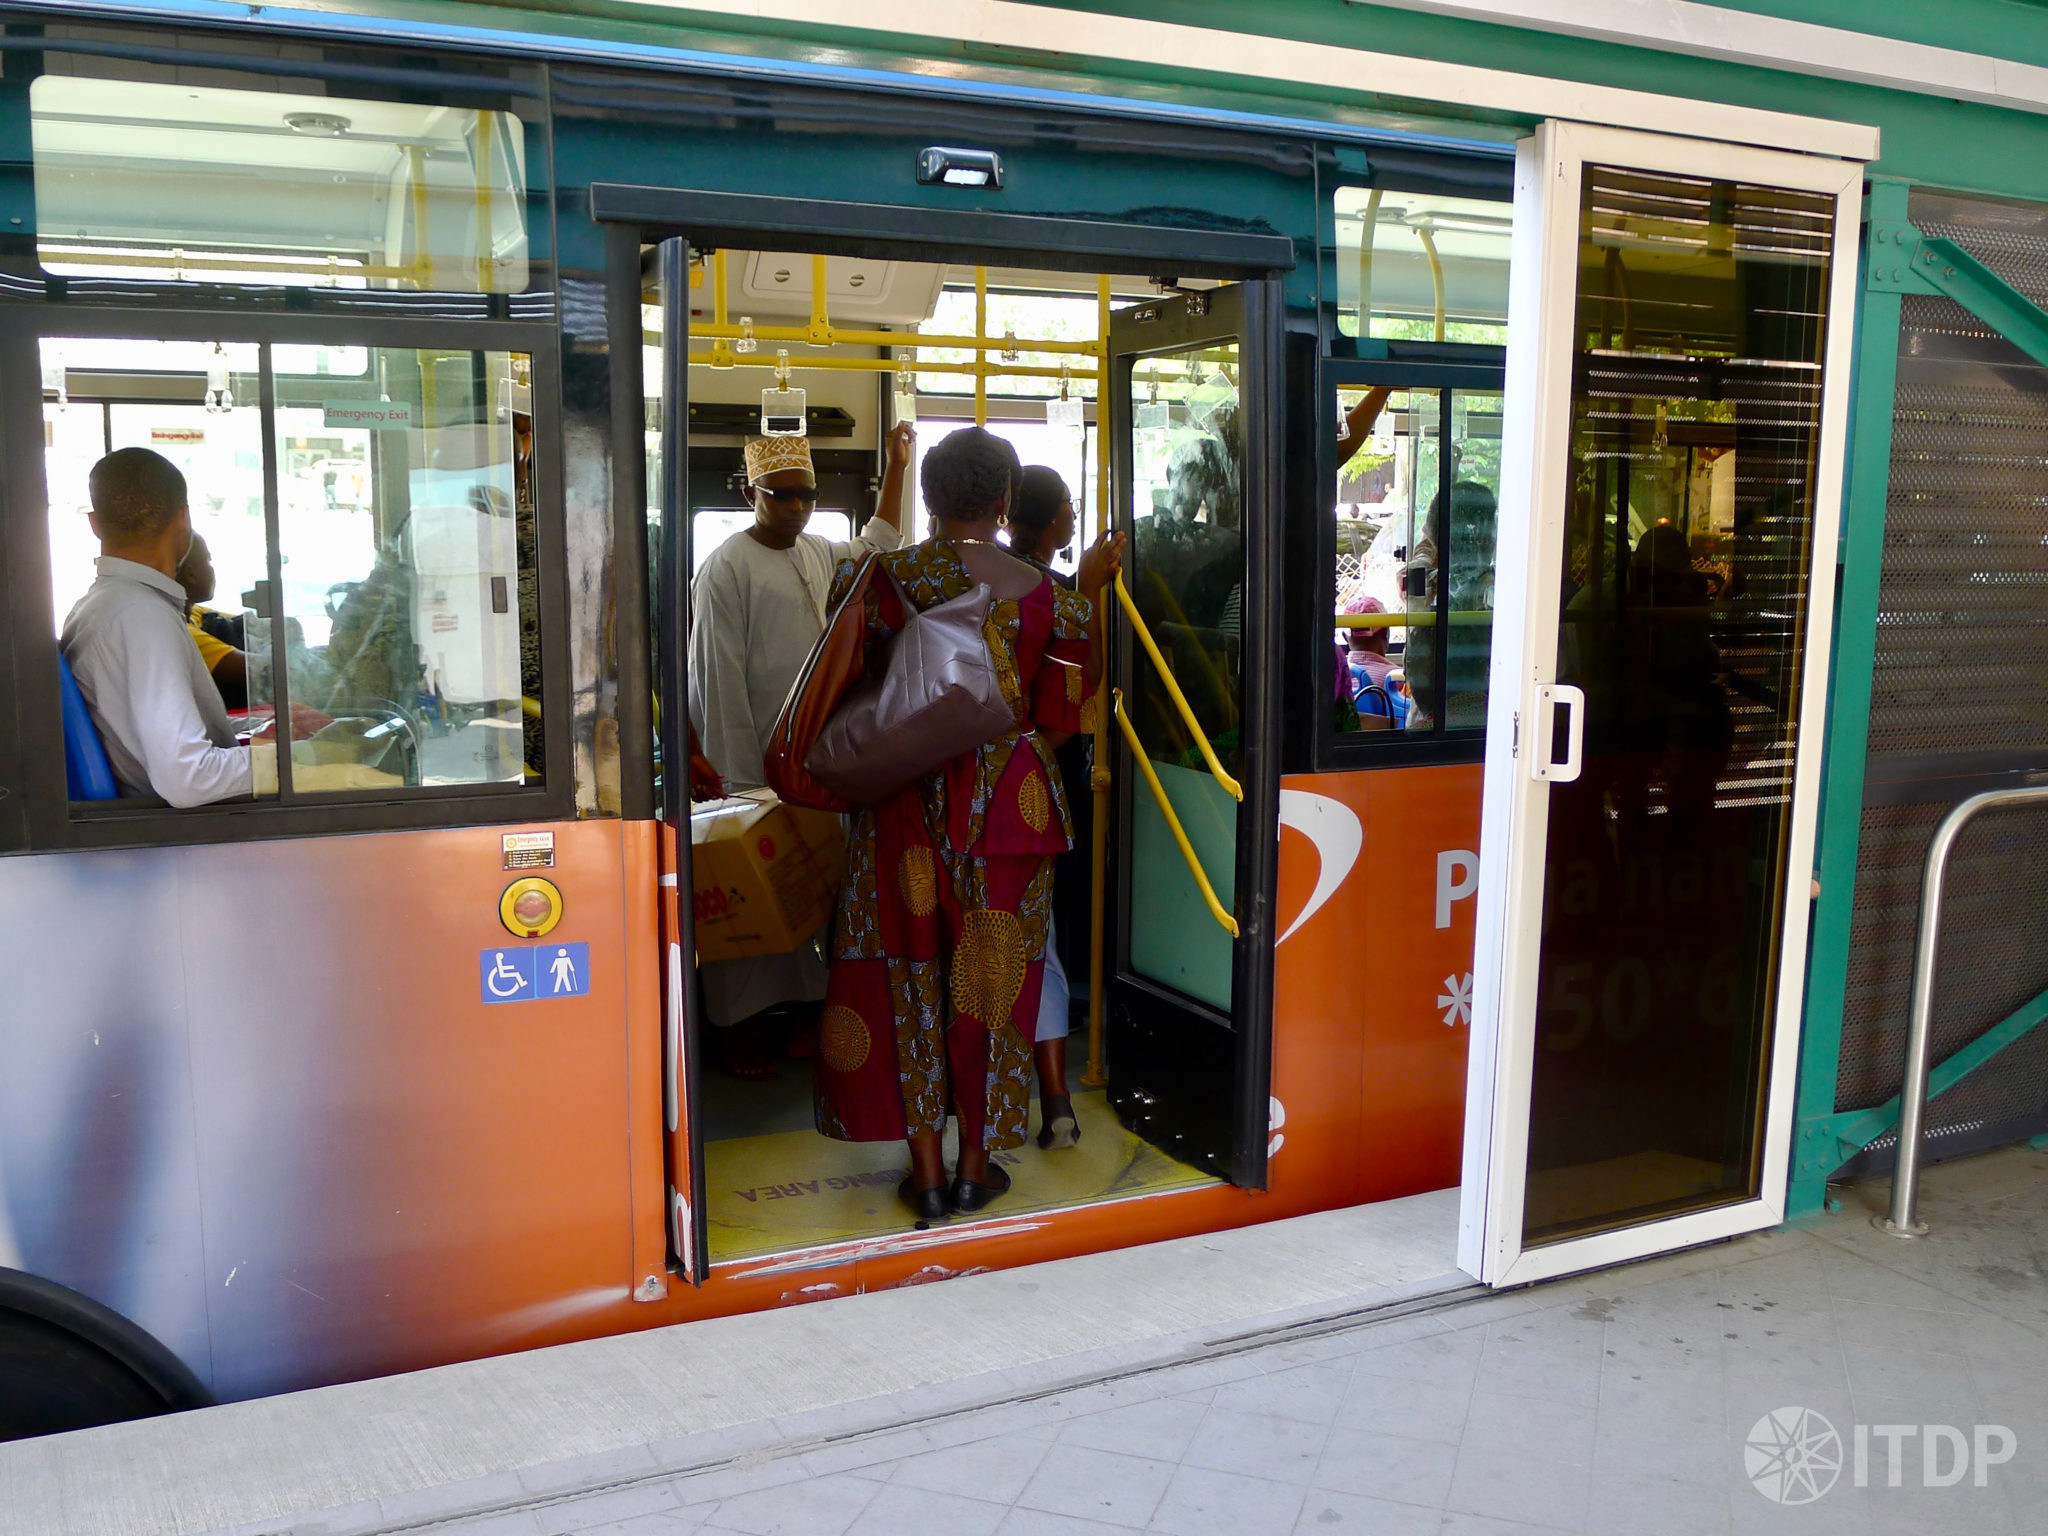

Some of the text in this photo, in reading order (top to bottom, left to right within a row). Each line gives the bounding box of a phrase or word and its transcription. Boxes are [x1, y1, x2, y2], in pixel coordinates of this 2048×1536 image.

[326, 407, 409, 422] Emergency Exit
[734, 1179, 820, 1203] AREA
